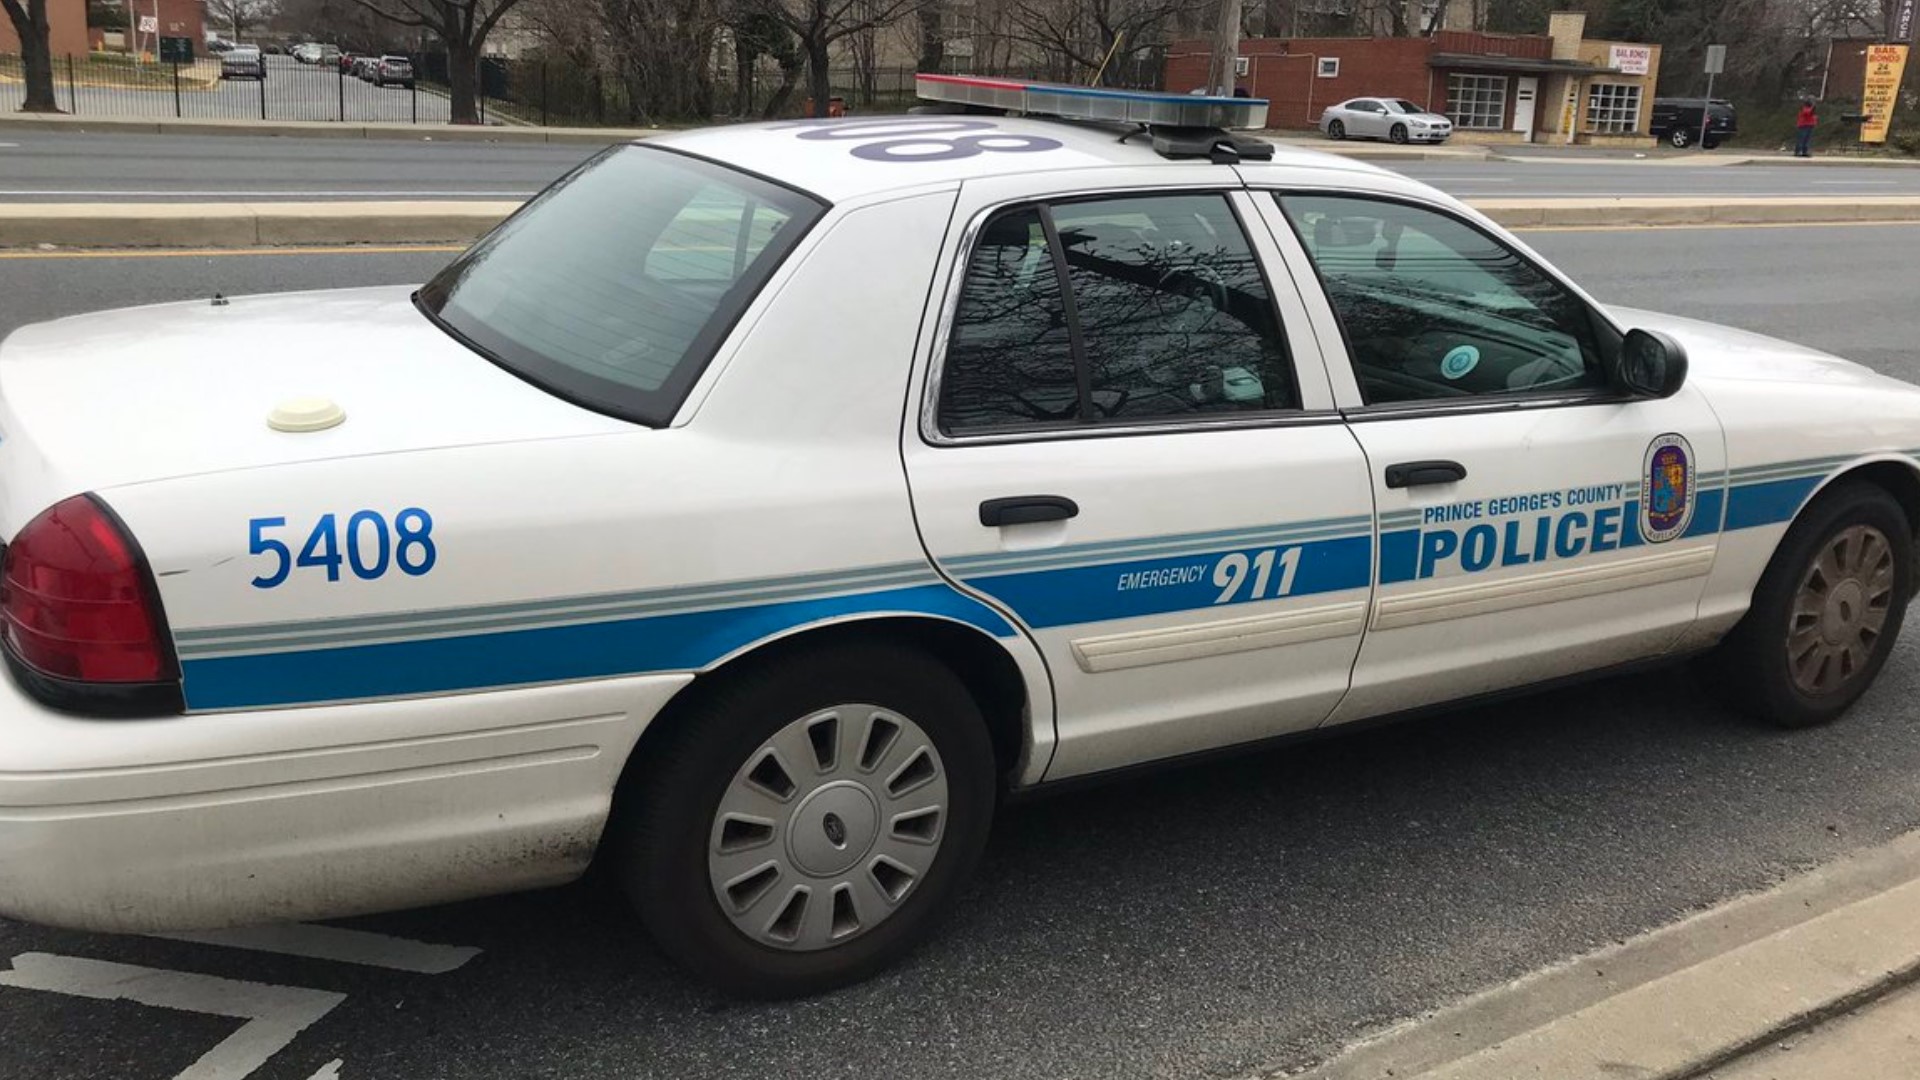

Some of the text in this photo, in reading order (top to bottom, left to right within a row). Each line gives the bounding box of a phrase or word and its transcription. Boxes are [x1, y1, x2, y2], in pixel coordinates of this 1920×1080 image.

[1869, 54, 1901, 63] BONDS
[1877, 63, 1888, 71] 24
[1424, 484, 1623, 524] PRINCE GEORGE'S COUNTY
[249, 507, 436, 588] 5408
[1419, 505, 1621, 579] POLICE
[1117, 546, 1302, 604] EMERGENCY 911
